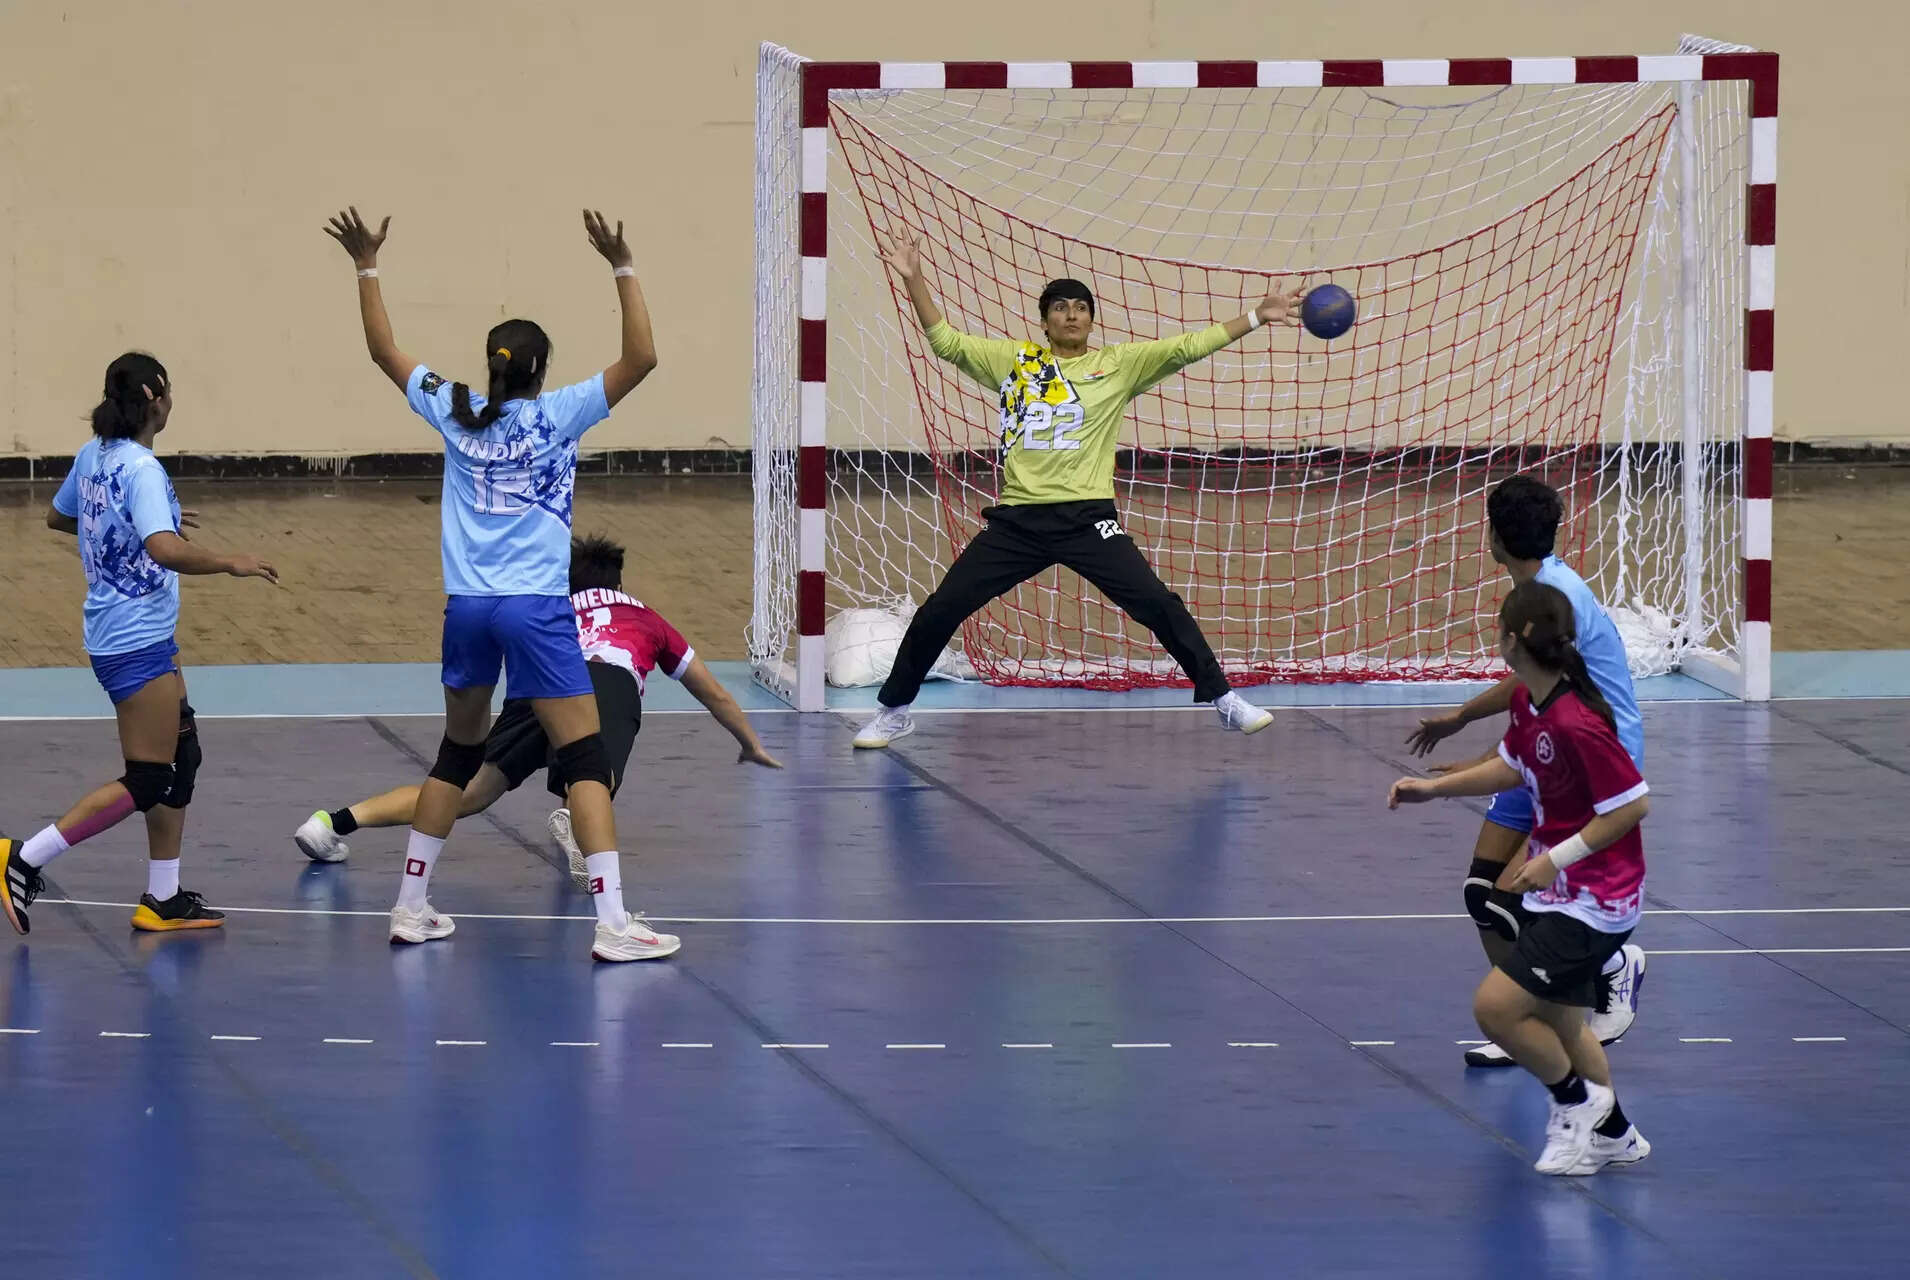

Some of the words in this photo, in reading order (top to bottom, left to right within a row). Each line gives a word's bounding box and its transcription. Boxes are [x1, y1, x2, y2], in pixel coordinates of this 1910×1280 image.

[1023, 401, 1085, 450] 22
[457, 435, 538, 462] INDIA
[1094, 518, 1126, 540] 22
